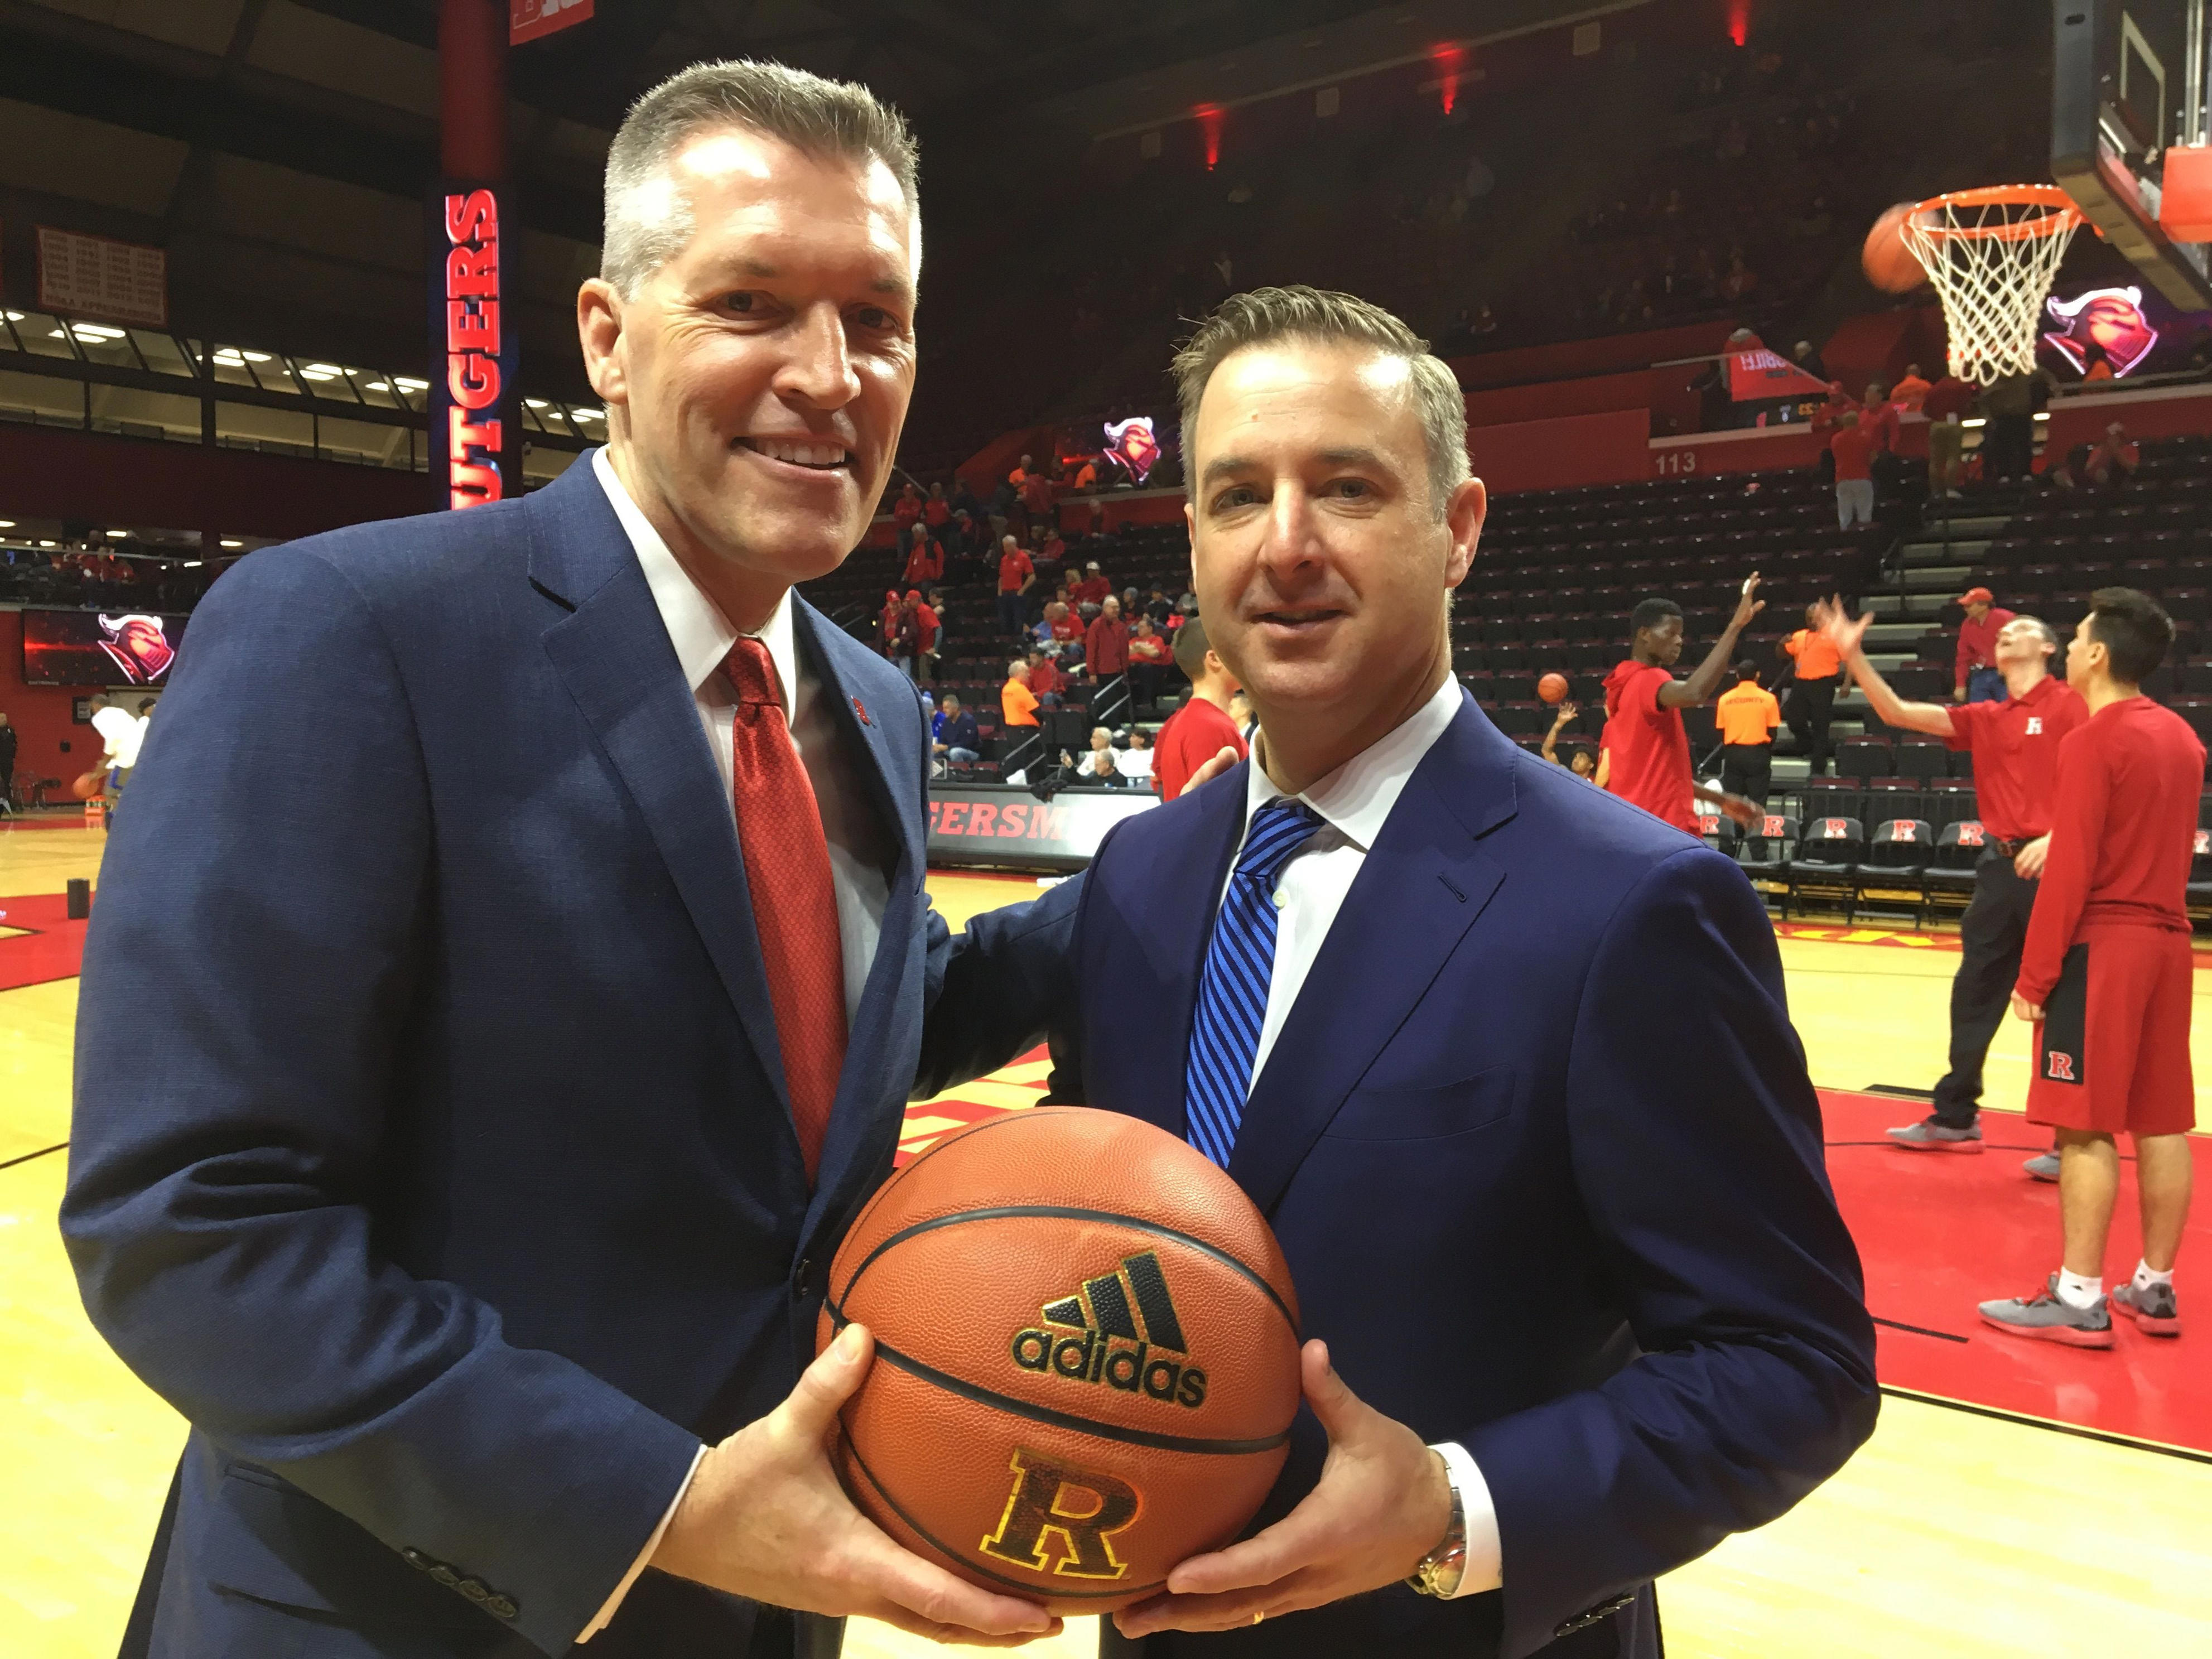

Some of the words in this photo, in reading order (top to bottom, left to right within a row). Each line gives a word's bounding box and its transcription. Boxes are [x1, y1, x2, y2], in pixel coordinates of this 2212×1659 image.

[1655, 451, 1696, 475] 113
[2025, 717, 2043, 735] R
[1761, 815, 1785, 837] R
[1824, 818, 1847, 839] R
[1891, 819, 1916, 842] R
[1958, 823, 1984, 846] R
[2048, 1050, 2075, 1081] R
[1010, 1327, 1208, 1409] adidas
[978, 1445, 1145, 1580] R
